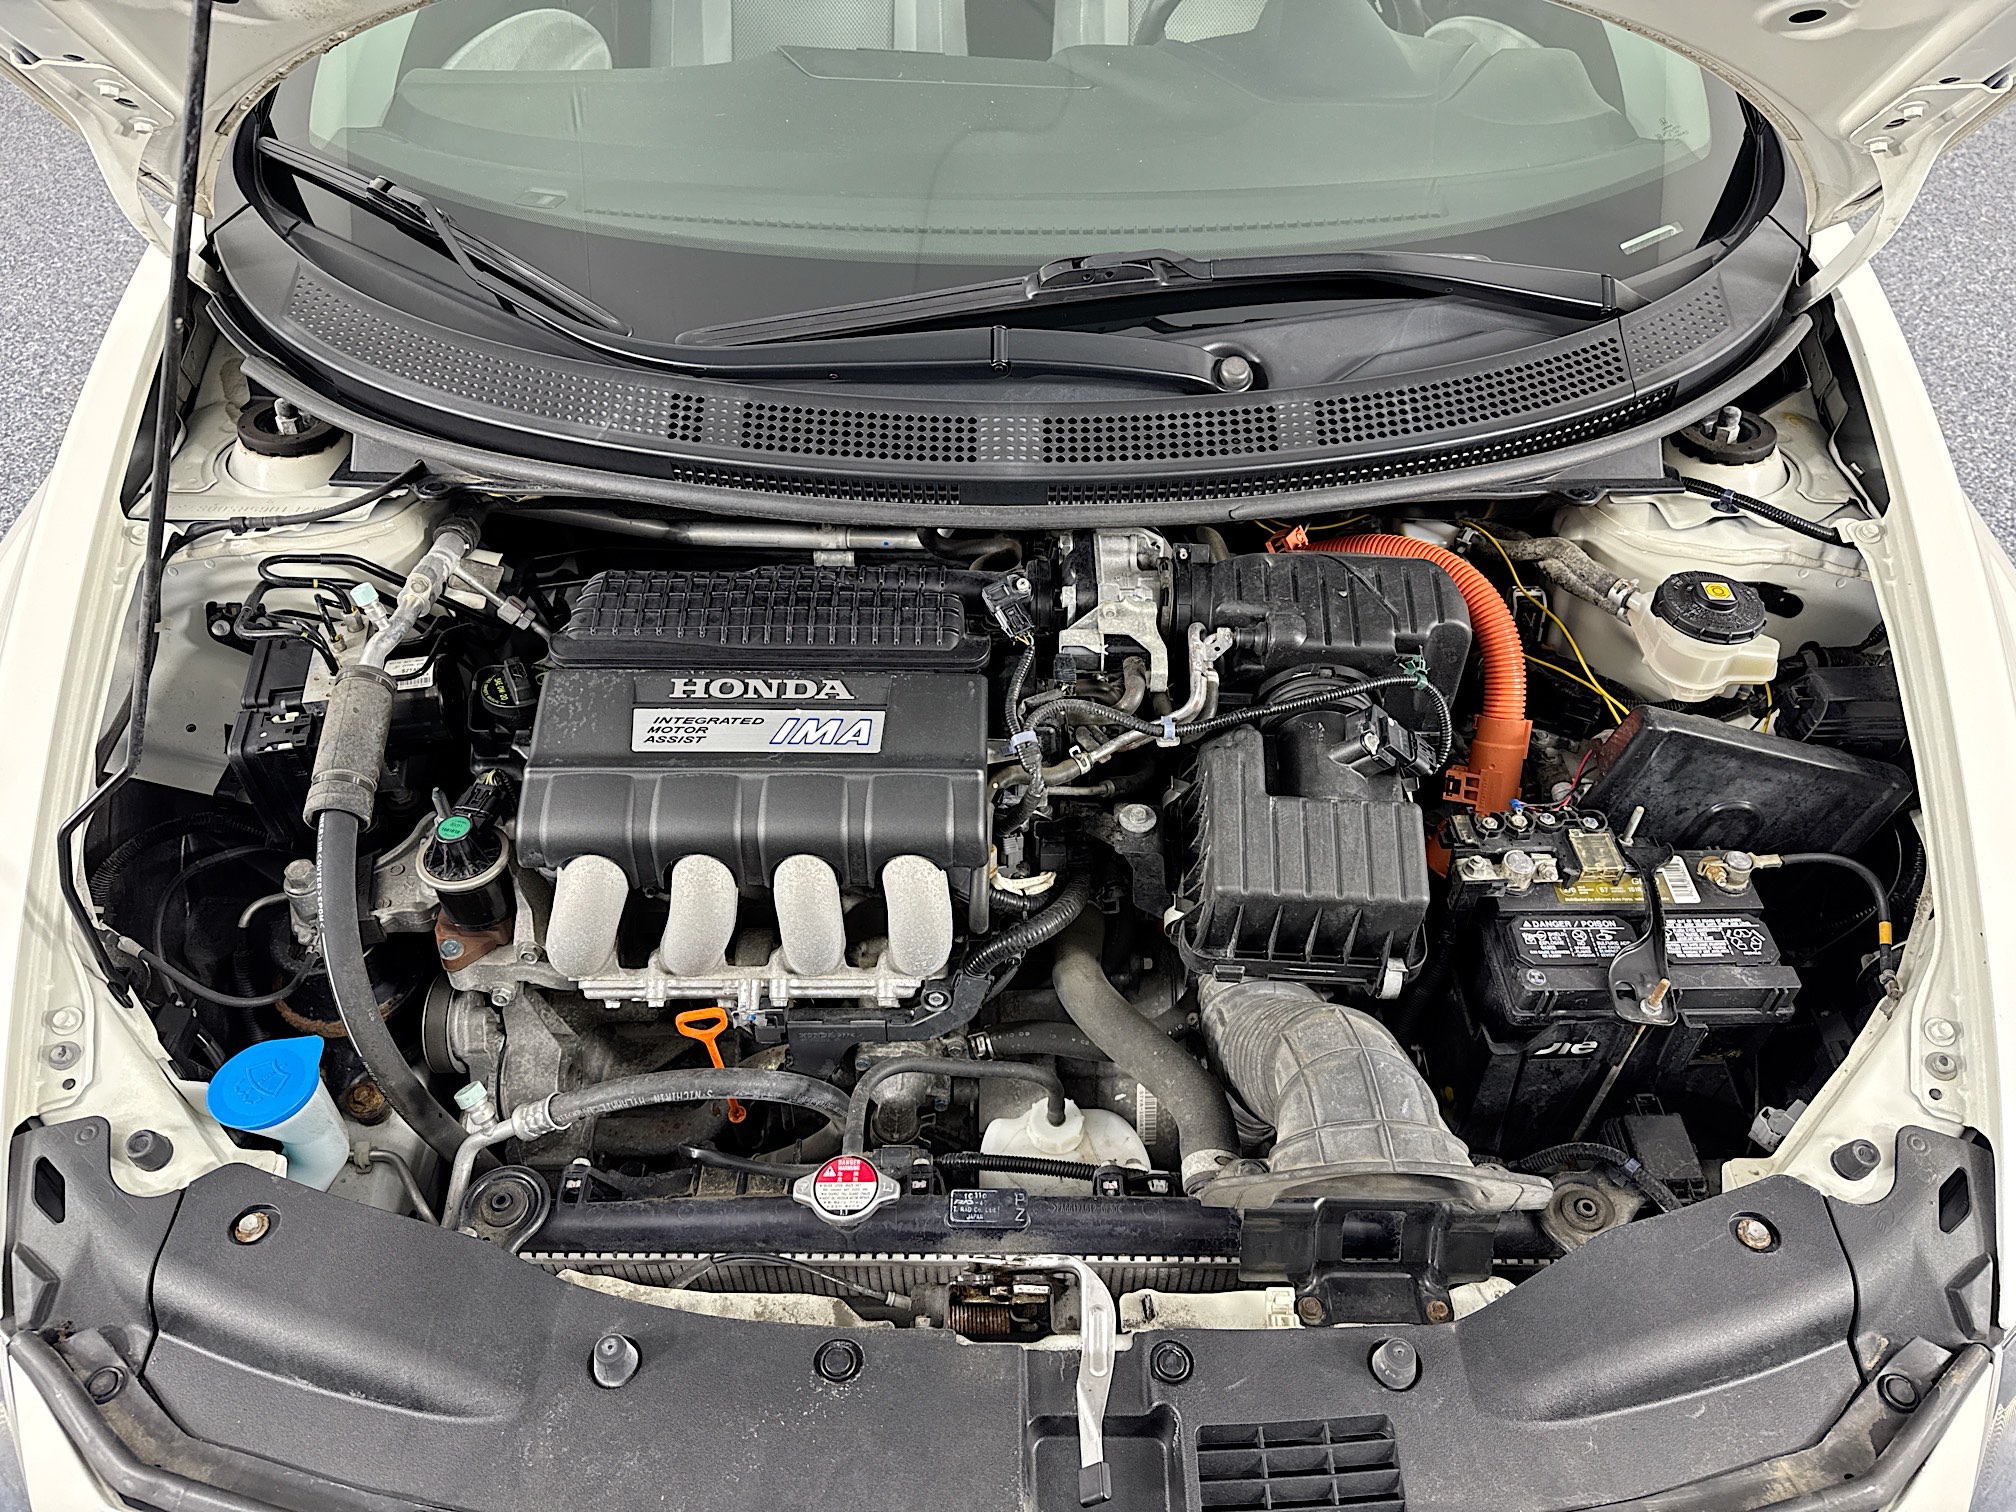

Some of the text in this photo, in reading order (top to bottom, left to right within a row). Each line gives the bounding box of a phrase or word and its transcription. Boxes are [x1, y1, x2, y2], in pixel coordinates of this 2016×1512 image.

[668, 678, 855, 700] HONDA
[653, 716, 766, 725] INTEGRATED
[646, 726, 710, 735] MOTOR
[769, 718, 873, 746] IMA
[643, 735, 708, 744] ASSIST
[1532, 920, 1572, 928] DANGER
[1581, 920, 1617, 928] POISON
[1014, 1207, 1025, 1222] Z
